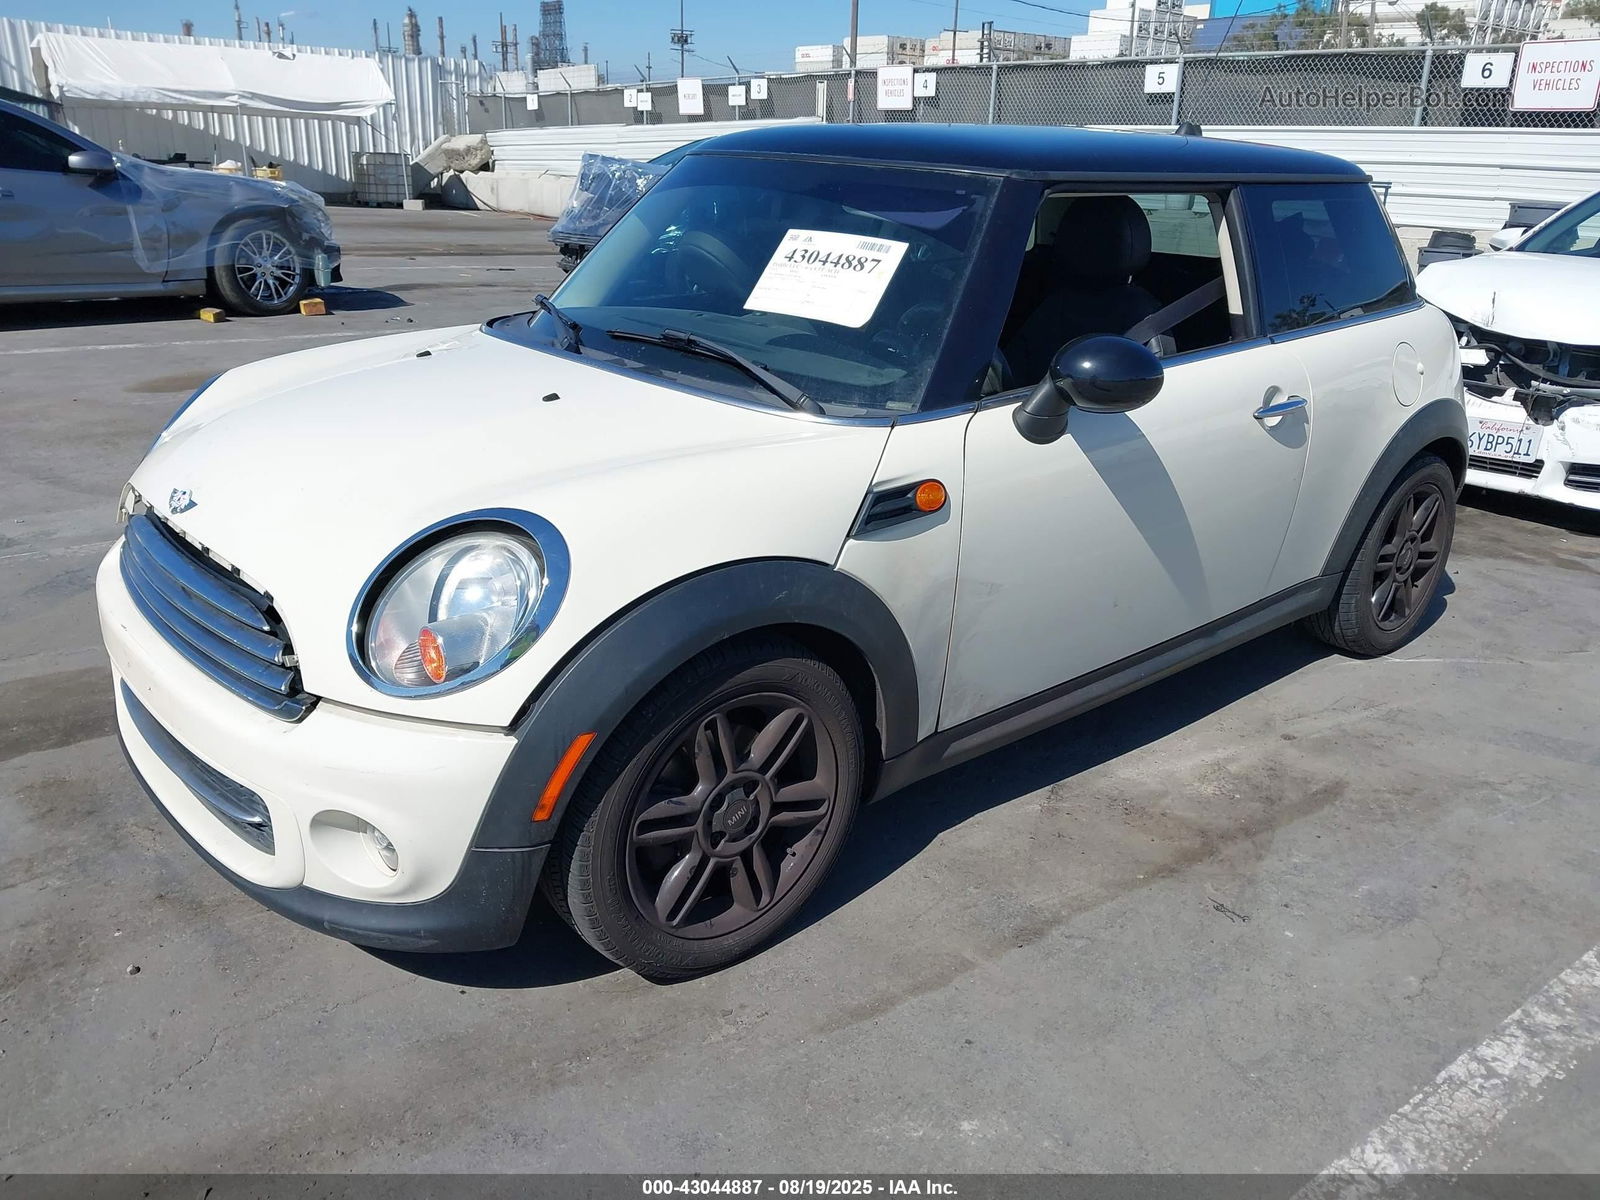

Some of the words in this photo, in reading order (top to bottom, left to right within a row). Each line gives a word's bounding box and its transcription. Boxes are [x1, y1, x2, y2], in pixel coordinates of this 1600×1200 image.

[1481, 62, 1494, 79] 6
[1526, 60, 1595, 74] INSPECTIONS
[882, 78, 909, 87] INSPECTIONS
[922, 79, 928, 91] 4
[1157, 71, 1166, 86] 5
[1532, 78, 1582, 91] VEHICLES
[757, 84, 762, 94] 3
[628, 94, 633, 102] 2
[784, 248, 882, 274] 43044887
[727, 805, 747, 826] MINI
